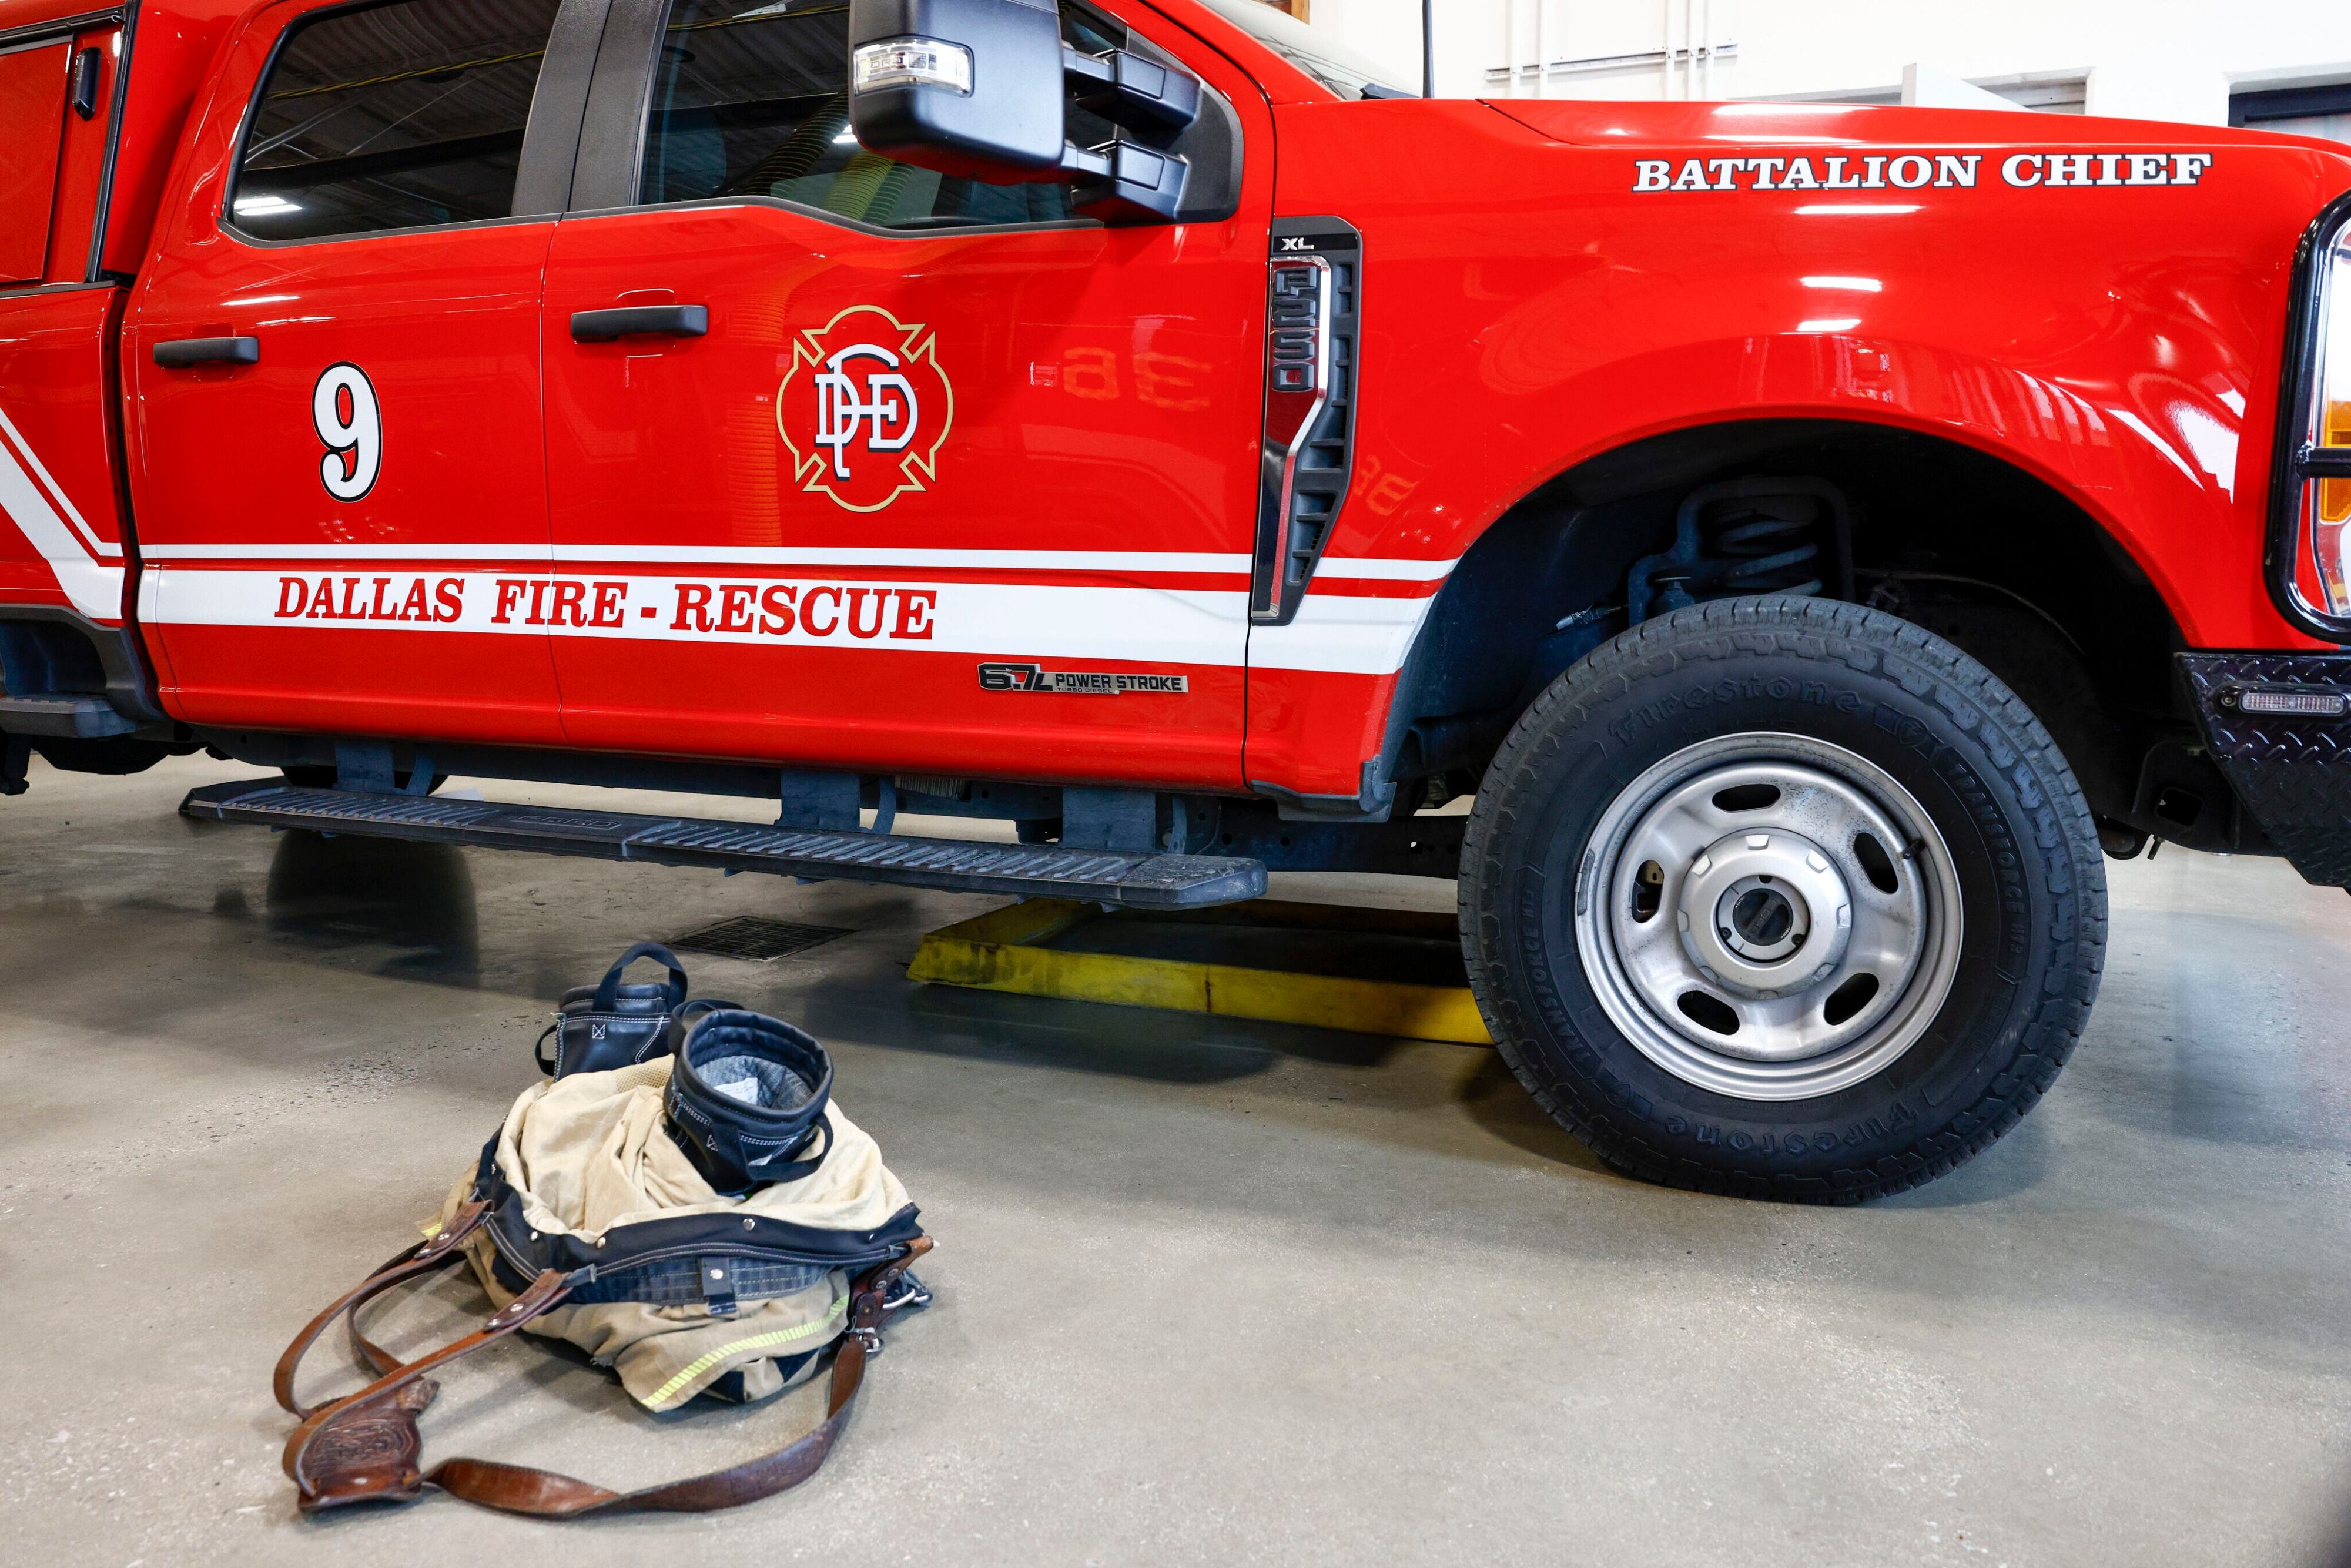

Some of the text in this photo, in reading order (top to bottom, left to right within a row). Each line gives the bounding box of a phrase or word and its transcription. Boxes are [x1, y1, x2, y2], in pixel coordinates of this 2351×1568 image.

[1631, 152, 2213, 192] BATTALION CHIEF
[1281, 237, 1315, 252] XL
[312, 360, 383, 503] 9
[274, 577, 465, 623] DALLAS
[491, 579, 628, 628] FIRE
[669, 584, 937, 640] RESCUE
[977, 662, 1183, 691] 6.7L POWER STROKE
[1607, 672, 1863, 748] Firestone
[1950, 763, 2024, 913] TRANSFORCE
[1663, 1098, 1919, 1157] Firestone
